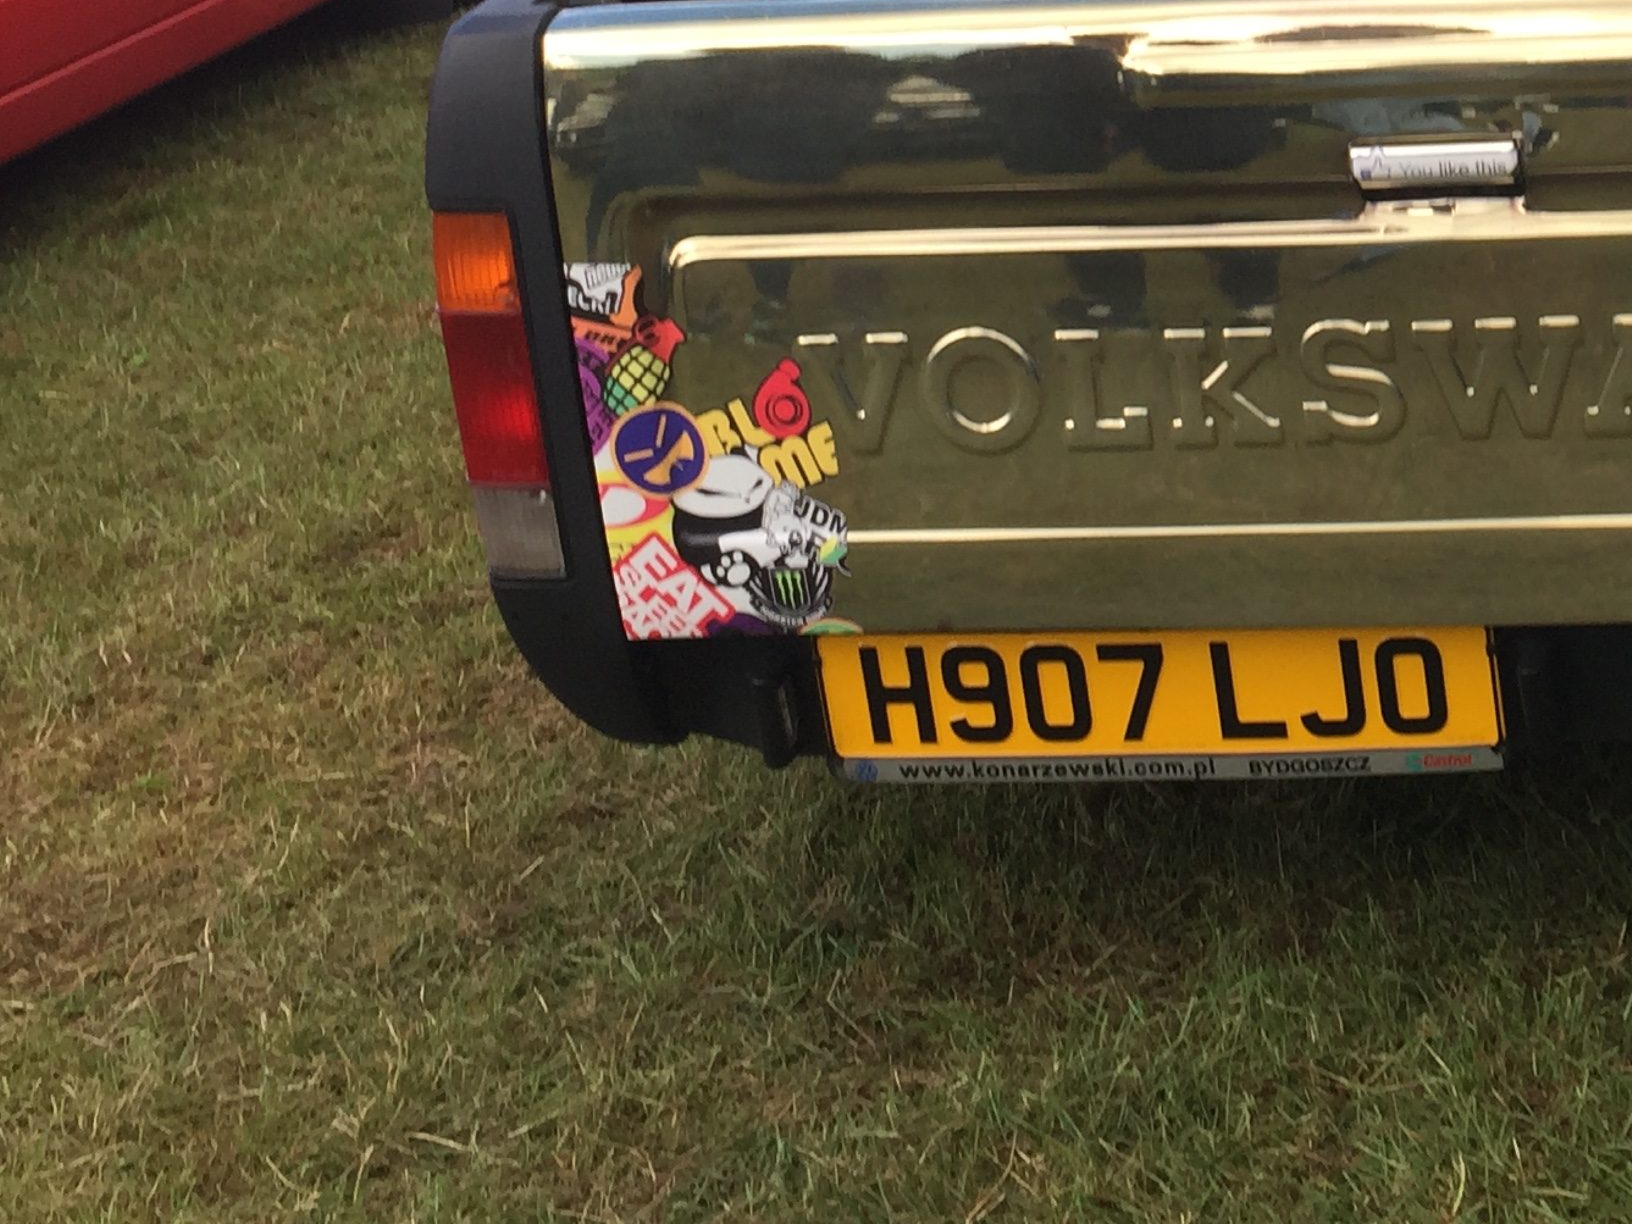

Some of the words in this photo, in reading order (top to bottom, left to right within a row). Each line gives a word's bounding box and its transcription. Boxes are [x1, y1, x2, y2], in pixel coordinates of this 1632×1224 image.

[1401, 164, 1433, 178] You
[1439, 160, 1470, 177] like
[628, 535, 730, 631] EAT
[857, 642, 1164, 745] H907
[1207, 636, 1450, 741] LJO
